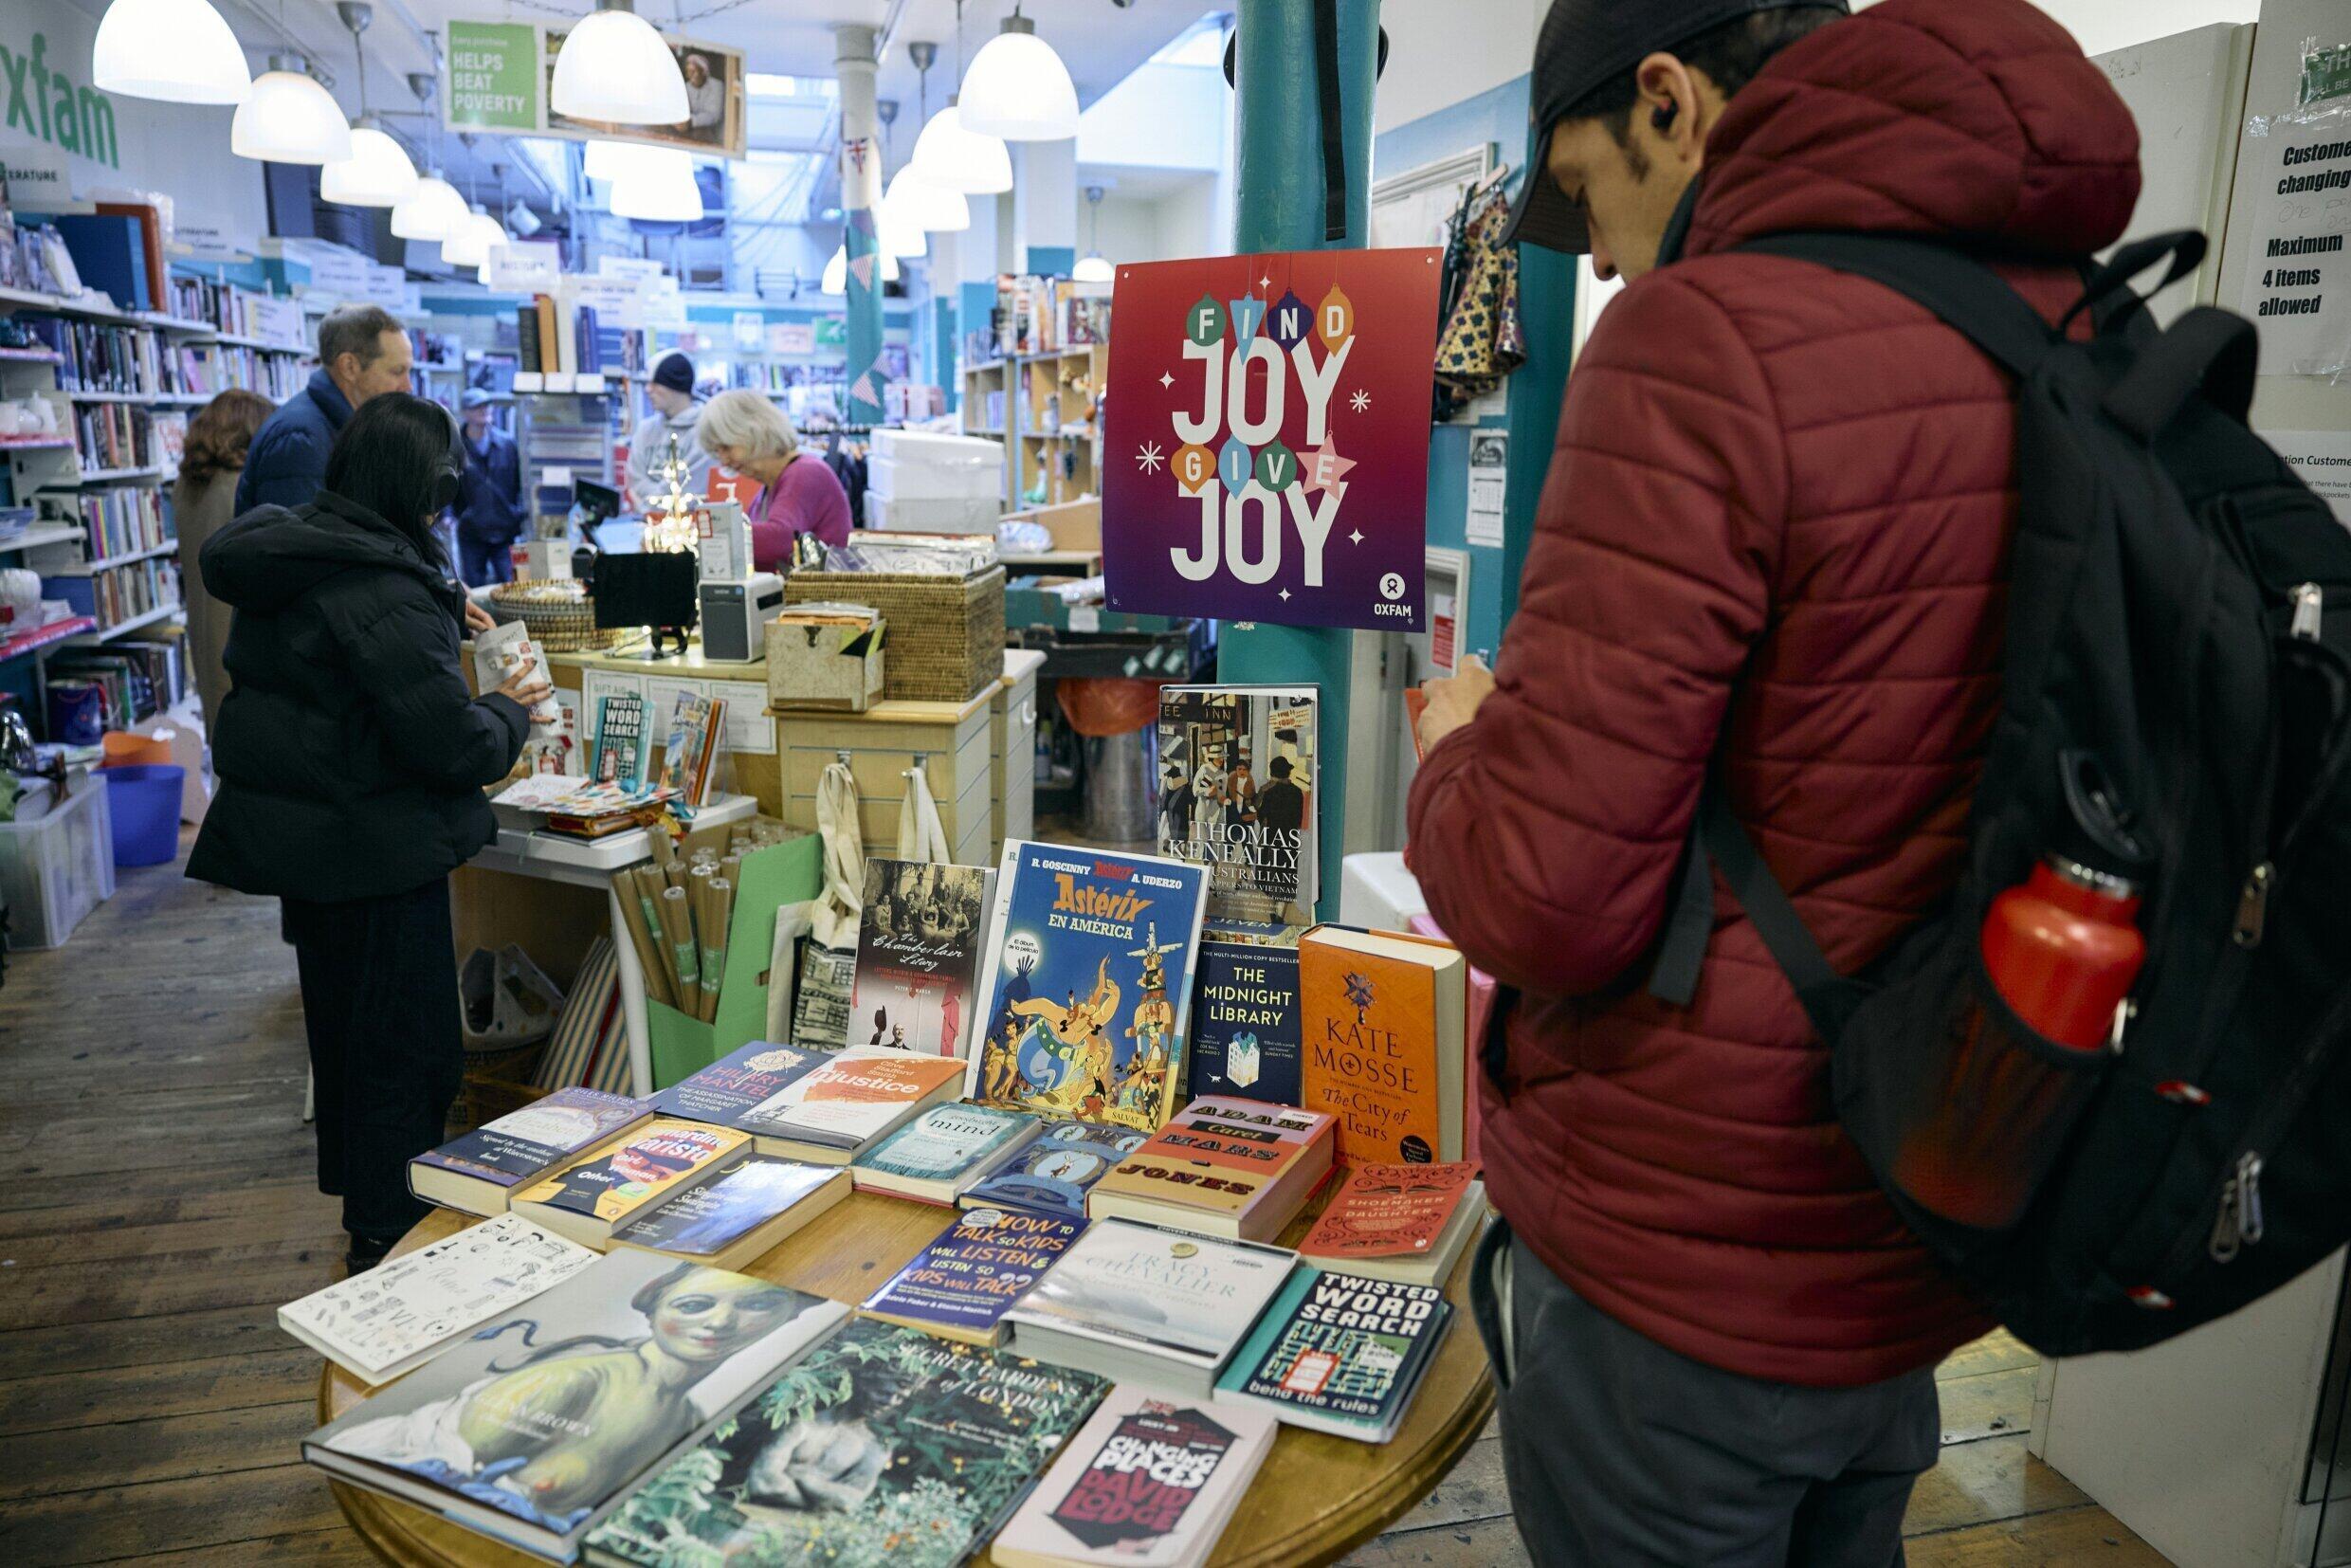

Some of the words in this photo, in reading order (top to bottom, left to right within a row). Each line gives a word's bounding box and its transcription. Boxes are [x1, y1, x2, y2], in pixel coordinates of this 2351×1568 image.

[452, 51, 504, 71] HELPS
[2324, 50, 2351, 73] TH
[454, 72, 493, 92] BEAT
[0, 32, 119, 171] xfam
[454, 92, 527, 114] POVERTY
[2283, 140, 2351, 166] Custome
[8, 169, 58, 183] ERATURE
[2277, 169, 2351, 195] changing
[2267, 234, 2343, 257] Maximum
[2262, 269, 2273, 287] 4
[2275, 268, 2321, 287] items
[2258, 295, 2323, 316] allowed
[1198, 305, 1345, 339] FIND
[1172, 335, 1356, 447] JOY
[1185, 451, 1336, 485] GIVE
[2306, 455, 2351, 466] Custome
[1170, 478, 1349, 587] JOY
[1374, 604, 1412, 617] OXFAM
[607, 698, 643, 710] TWISTED
[1205, 709, 1231, 720] INN
[606, 709, 641, 725] WORD
[604, 724, 639, 737] SEARCH
[1191, 821, 1302, 849] THOMAS
[1169, 839, 1303, 869] KENEALLY
[1031, 858, 1041, 867] R.
[1042, 858, 1091, 876] GOSCINNY
[1212, 866, 1300, 884] USTRALIANS
[1131, 873, 1140, 884] A.
[1142, 875, 1183, 889] UDERZO
[1212, 880, 1242, 889] APPERS
[1259, 884, 1298, 895] VIETNAM
[1052, 871, 1155, 922] Astérix
[1048, 914, 1066, 929] EN
[1069, 918, 1134, 939] AMÉRICA
[873, 935, 964, 957] Chamberlain
[900, 953, 939, 972] Litany
[1213, 952, 1252, 960] MULTI-MILLION
[1268, 956, 1300, 964] BESTSELLER
[1233, 967, 1266, 983] THE
[1204, 985, 1292, 1006] MIDNIGHT
[1210, 1002, 1284, 1026] LIBRARY
[1327, 1017, 1403, 1059] KATE
[711, 1067, 788, 1085] HILARY
[806, 1067, 920, 1094] Injustice
[1314, 1044, 1418, 1094] MOSSE
[689, 1074, 772, 1098] MANTEL
[694, 1088, 756, 1106] ASSASSINATION
[601, 1093, 635, 1105] MILTON
[677, 1100, 722, 1112] THATCHER
[690, 1095, 738, 1109] MARGARET
[1323, 1087, 1349, 1106] The
[1353, 1092, 1391, 1125] City
[1394, 1108, 1411, 1125] of
[929, 1120, 1000, 1136] mind
[1112, 1111, 1139, 1125] SALVAT
[1190, 1104, 1313, 1132] ADAM
[1342, 1110, 1388, 1141] Tears
[1158, 1133, 1279, 1160] MARS
[577, 1170, 615, 1183] Other
[1117, 1163, 1254, 1194] JONES
[1345, 1208, 1431, 1217] DAUGHTER
[1347, 1196, 1445, 1207] SHOEMAKER
[992, 1212, 1061, 1233] HOW
[1059, 1224, 1074, 1235] TO
[952, 1225, 1005, 1244] TALK
[997, 1235, 1015, 1247] SO
[1013, 1234, 1068, 1251] KIDS
[930, 1246, 957, 1258] WILL
[960, 1244, 1037, 1267] LISTEN
[1030, 1256, 1050, 1270] &
[930, 1258, 972, 1272] LISTEN
[975, 1265, 994, 1276] SO
[1128, 1249, 1217, 1277] TRACY
[902, 1268, 947, 1285] KIDS
[945, 1279, 973, 1291] WILL
[1085, 1256, 1236, 1298] CHEVALIER
[1324, 1272, 1440, 1302] TWISTED
[1315, 1285, 1432, 1320] WORD
[1300, 1304, 1423, 1337] SEARCH
[899, 1343, 979, 1372] SECRET
[962, 1379, 1060, 1417] LONDON
[1248, 1380, 1292, 1399] bend
[1296, 1390, 1327, 1407] the
[1331, 1397, 1379, 1415] rules
[1108, 1435, 1220, 1474] CHANGING
[1093, 1448, 1206, 1489] PLACES
[1081, 1466, 1195, 1509] DAVID
[1058, 1487, 1182, 1531] LODGE
